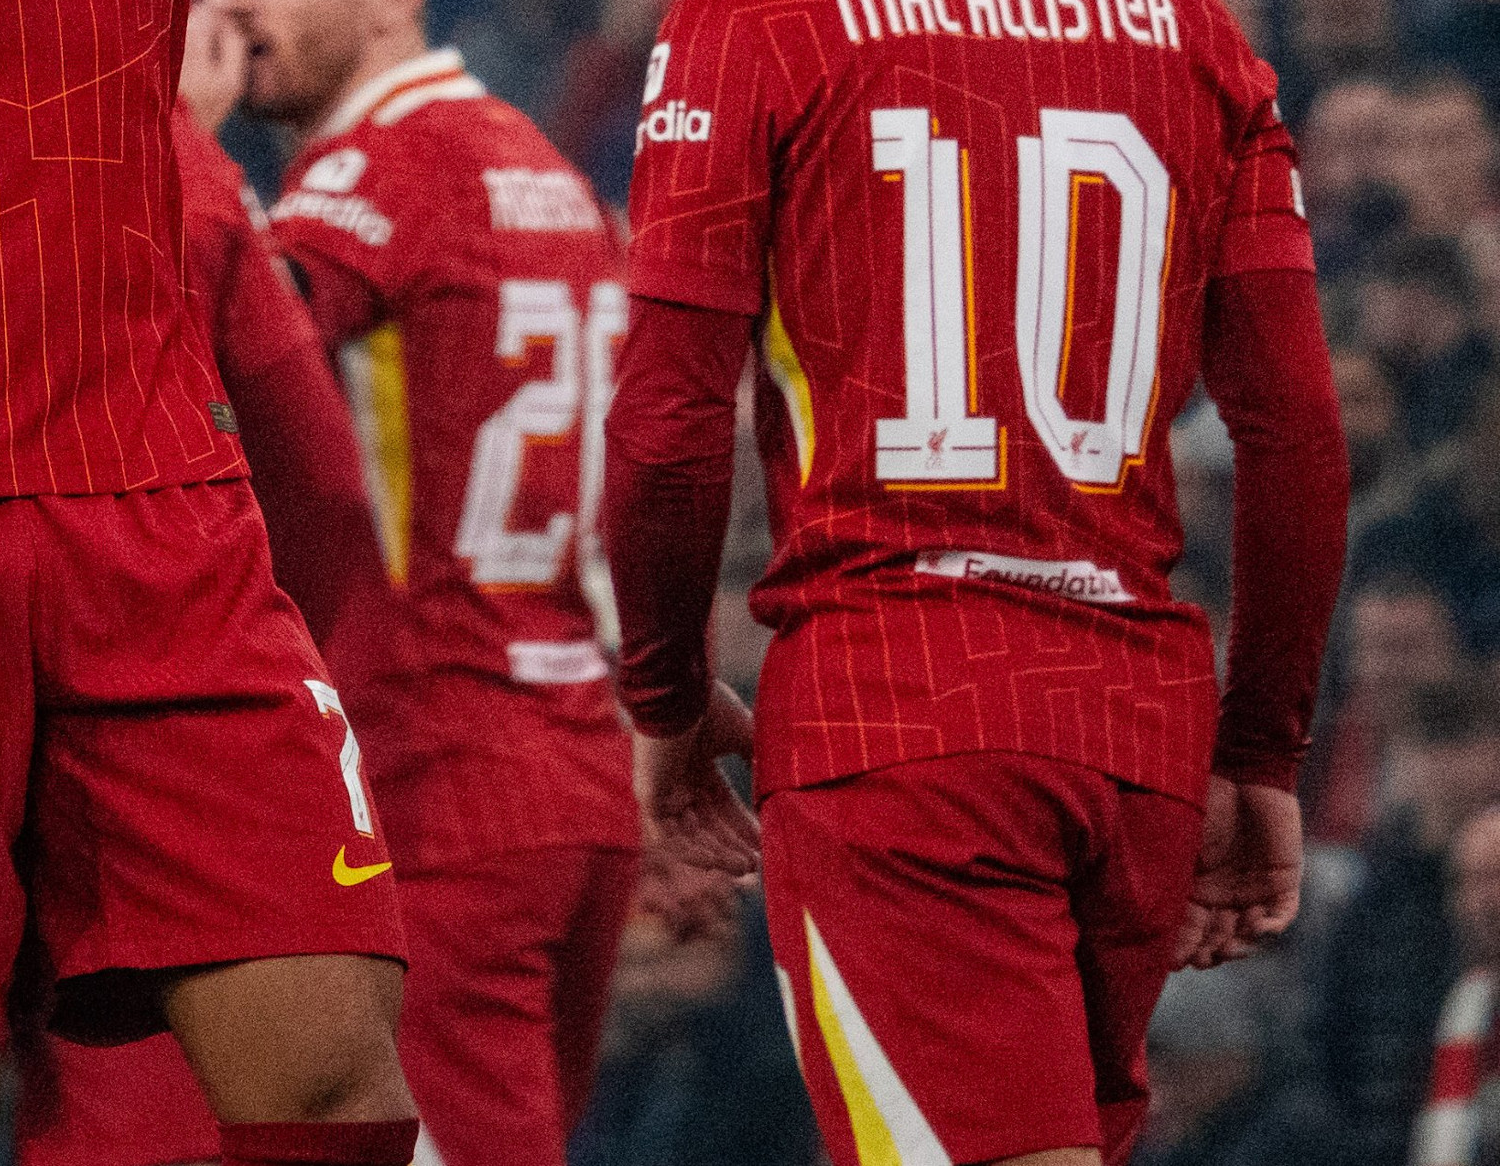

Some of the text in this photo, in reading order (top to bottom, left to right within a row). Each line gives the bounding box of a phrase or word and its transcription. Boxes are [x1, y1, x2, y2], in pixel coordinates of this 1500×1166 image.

[635, 100, 712, 155] dia
[871, 108, 1176, 489] 10
[303, 679, 374, 837] 7
